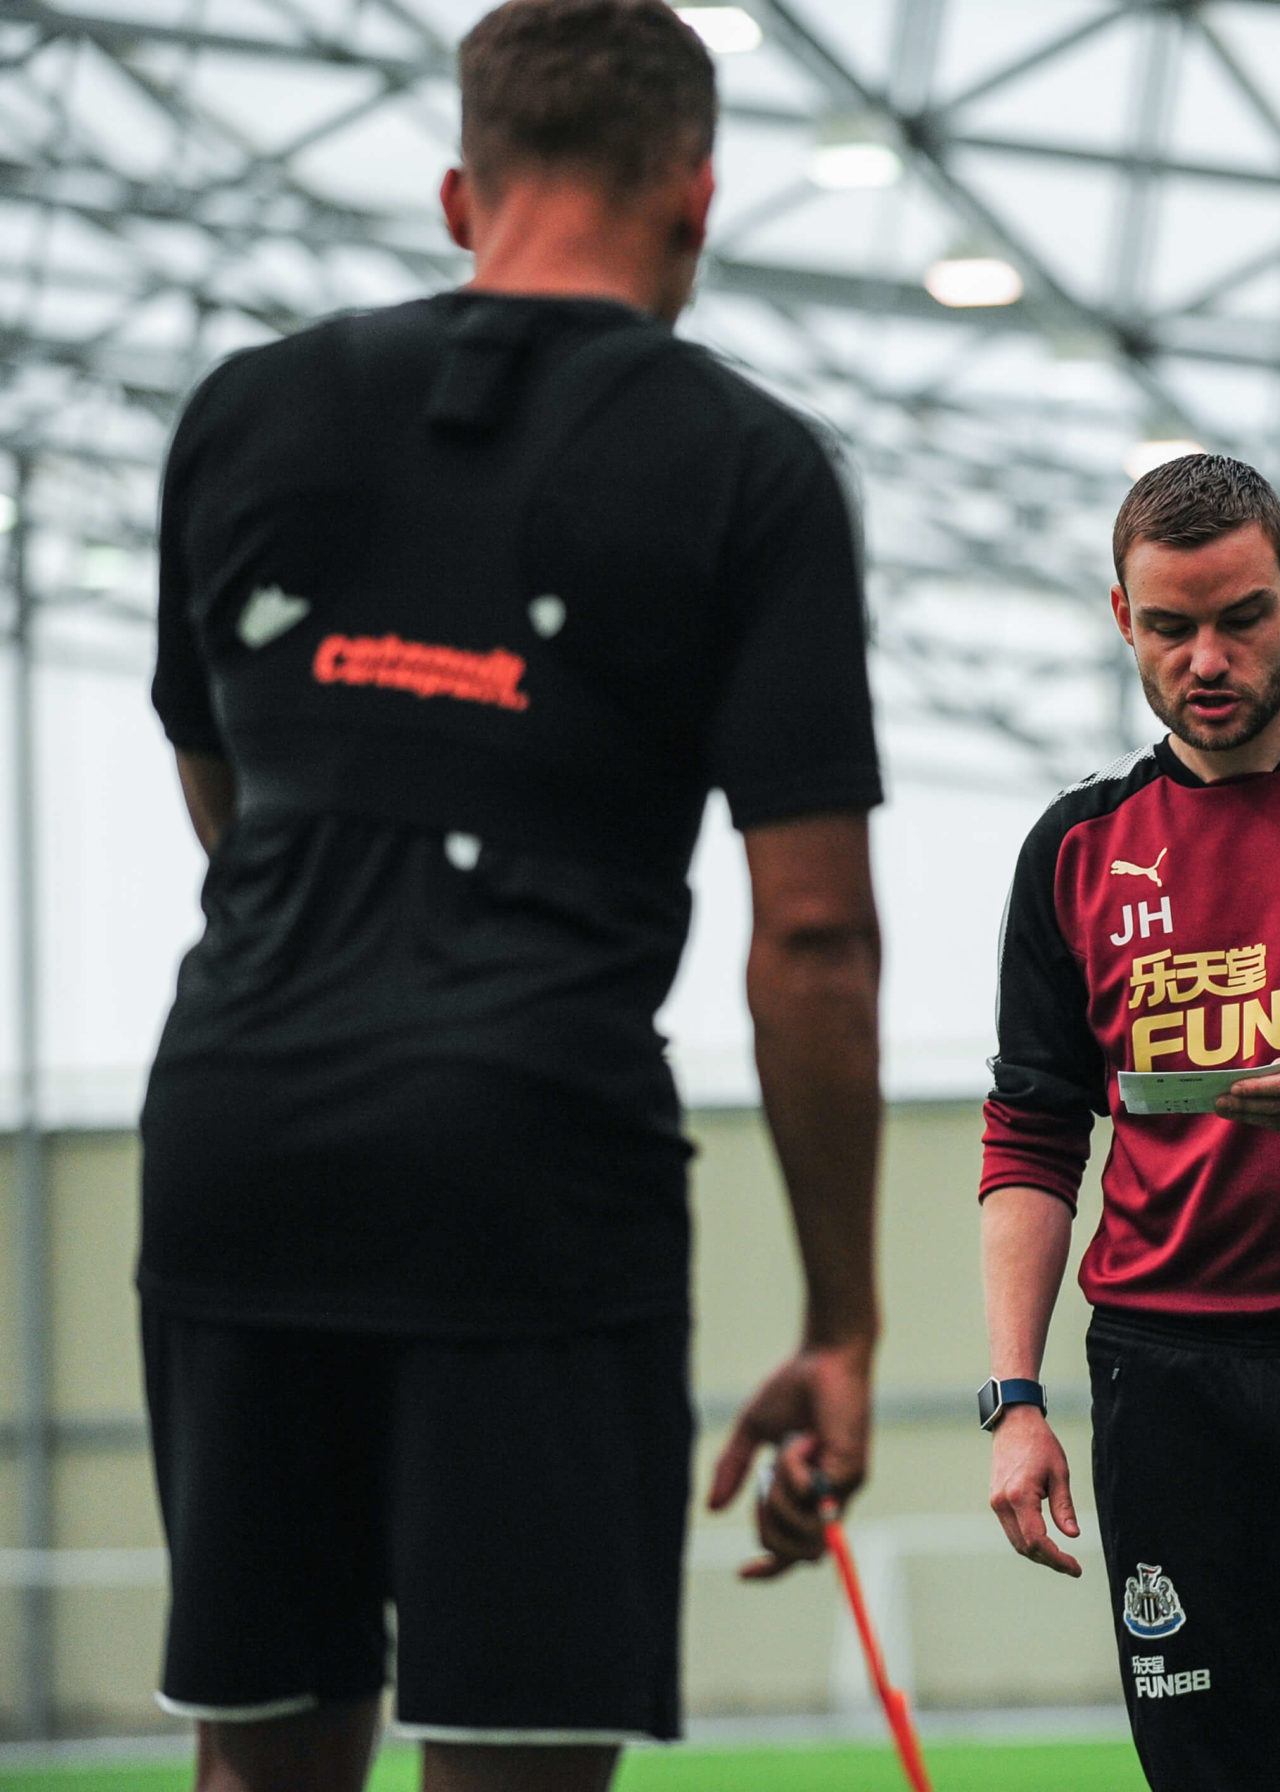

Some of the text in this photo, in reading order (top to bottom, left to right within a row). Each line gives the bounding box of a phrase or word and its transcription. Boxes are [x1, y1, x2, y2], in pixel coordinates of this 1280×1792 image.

[1110, 896, 1173, 946] JH
[1128, 943, 1266, 1009] 乐天堂
[1135, 1669, 1211, 1698] FUN88
